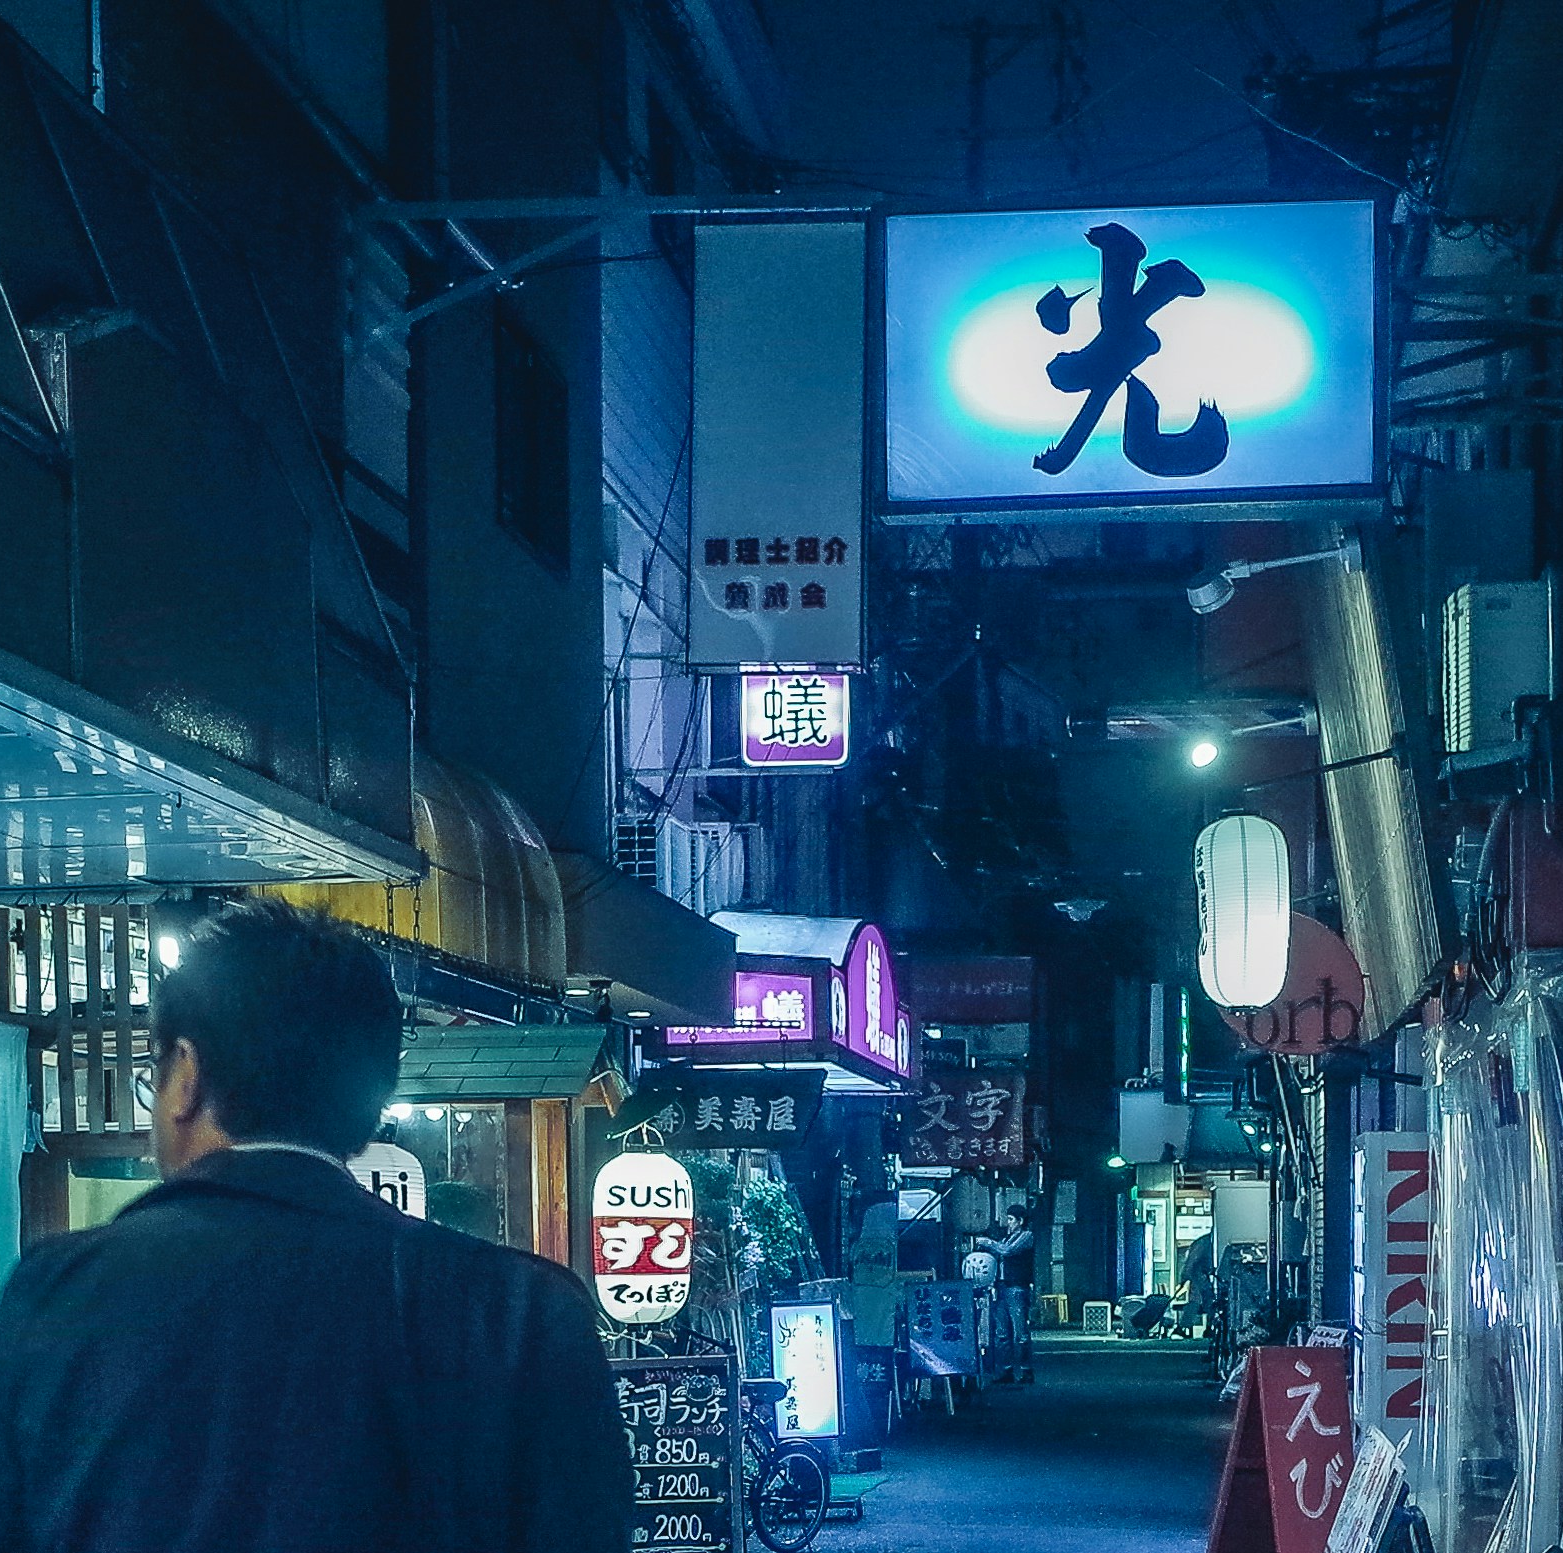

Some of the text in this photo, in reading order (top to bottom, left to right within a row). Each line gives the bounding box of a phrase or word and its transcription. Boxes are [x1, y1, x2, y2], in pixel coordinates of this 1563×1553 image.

[1032, 220, 1231, 477] 光
[762, 678, 828, 745] 蟻
[1245, 978, 1360, 1046] orb
[607, 1179, 691, 1208] sushi
[597, 1221, 691, 1270] すし
[1286, 1360, 1344, 1520] えび
